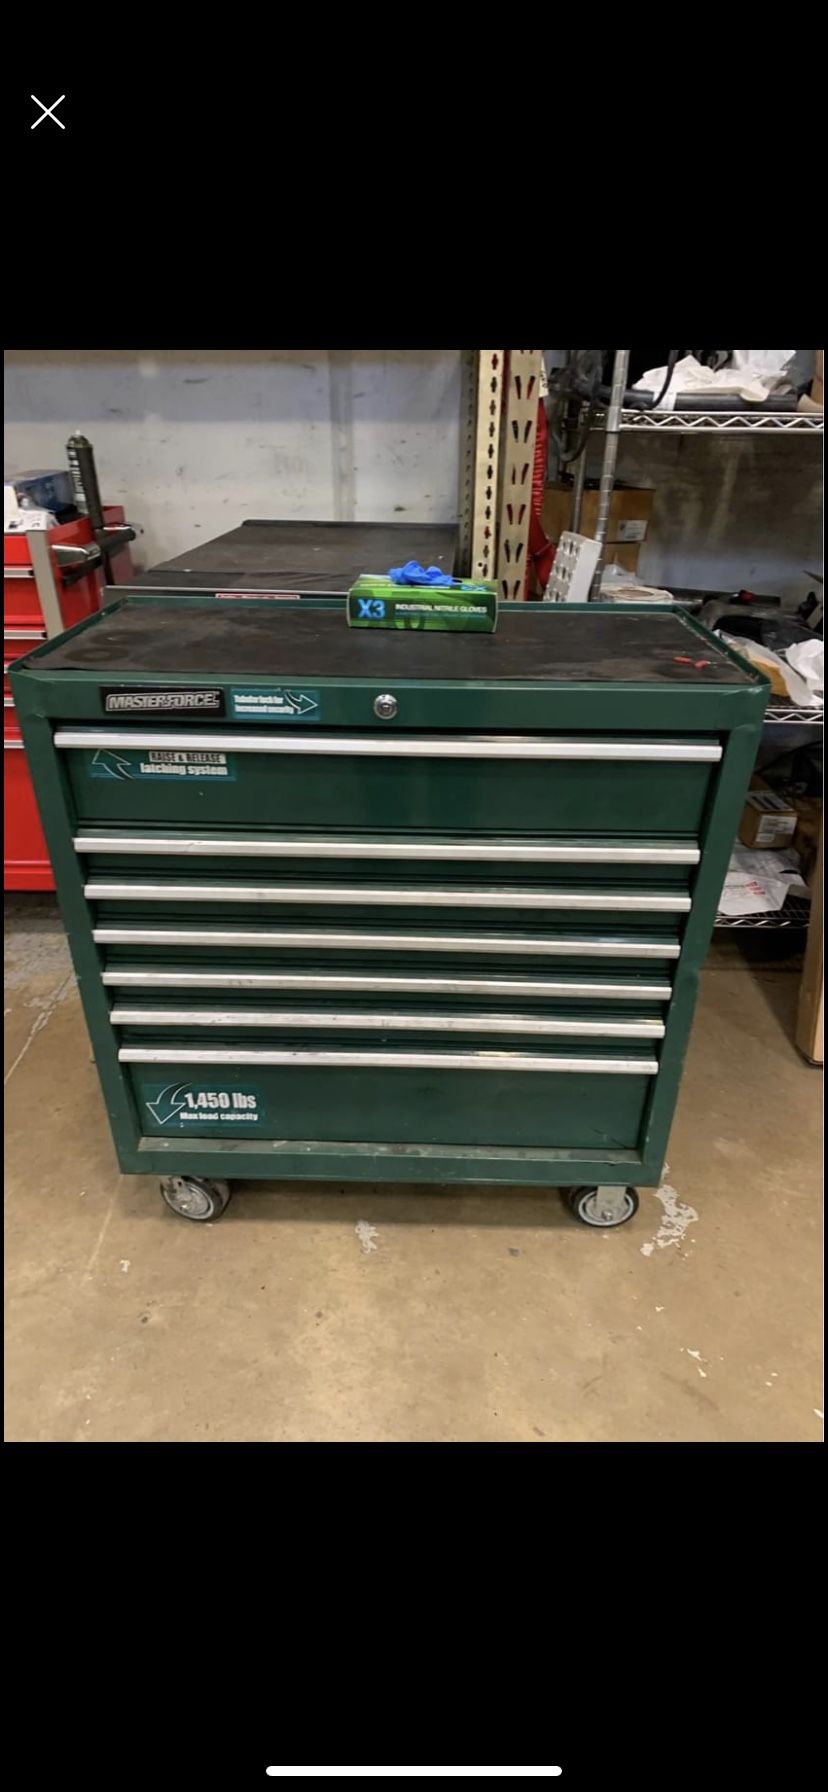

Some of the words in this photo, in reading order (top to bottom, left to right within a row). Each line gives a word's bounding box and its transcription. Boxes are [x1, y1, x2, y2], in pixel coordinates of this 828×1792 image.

[358, 599, 386, 618] X3
[459, 606, 487, 614] GLOVES
[151, 751, 177, 761] RAISE
[178, 753, 184, 762] &
[186, 753, 220, 762] RELEASE
[140, 763, 187, 775] latching
[187, 764, 228, 776] system
[184, 1092, 230, 1109] 1,450
[232, 1092, 257, 1109] lbs
[180, 1112, 199, 1120] Max
[199, 1112, 219, 1120] load
[220, 1112, 258, 1121] capacity
